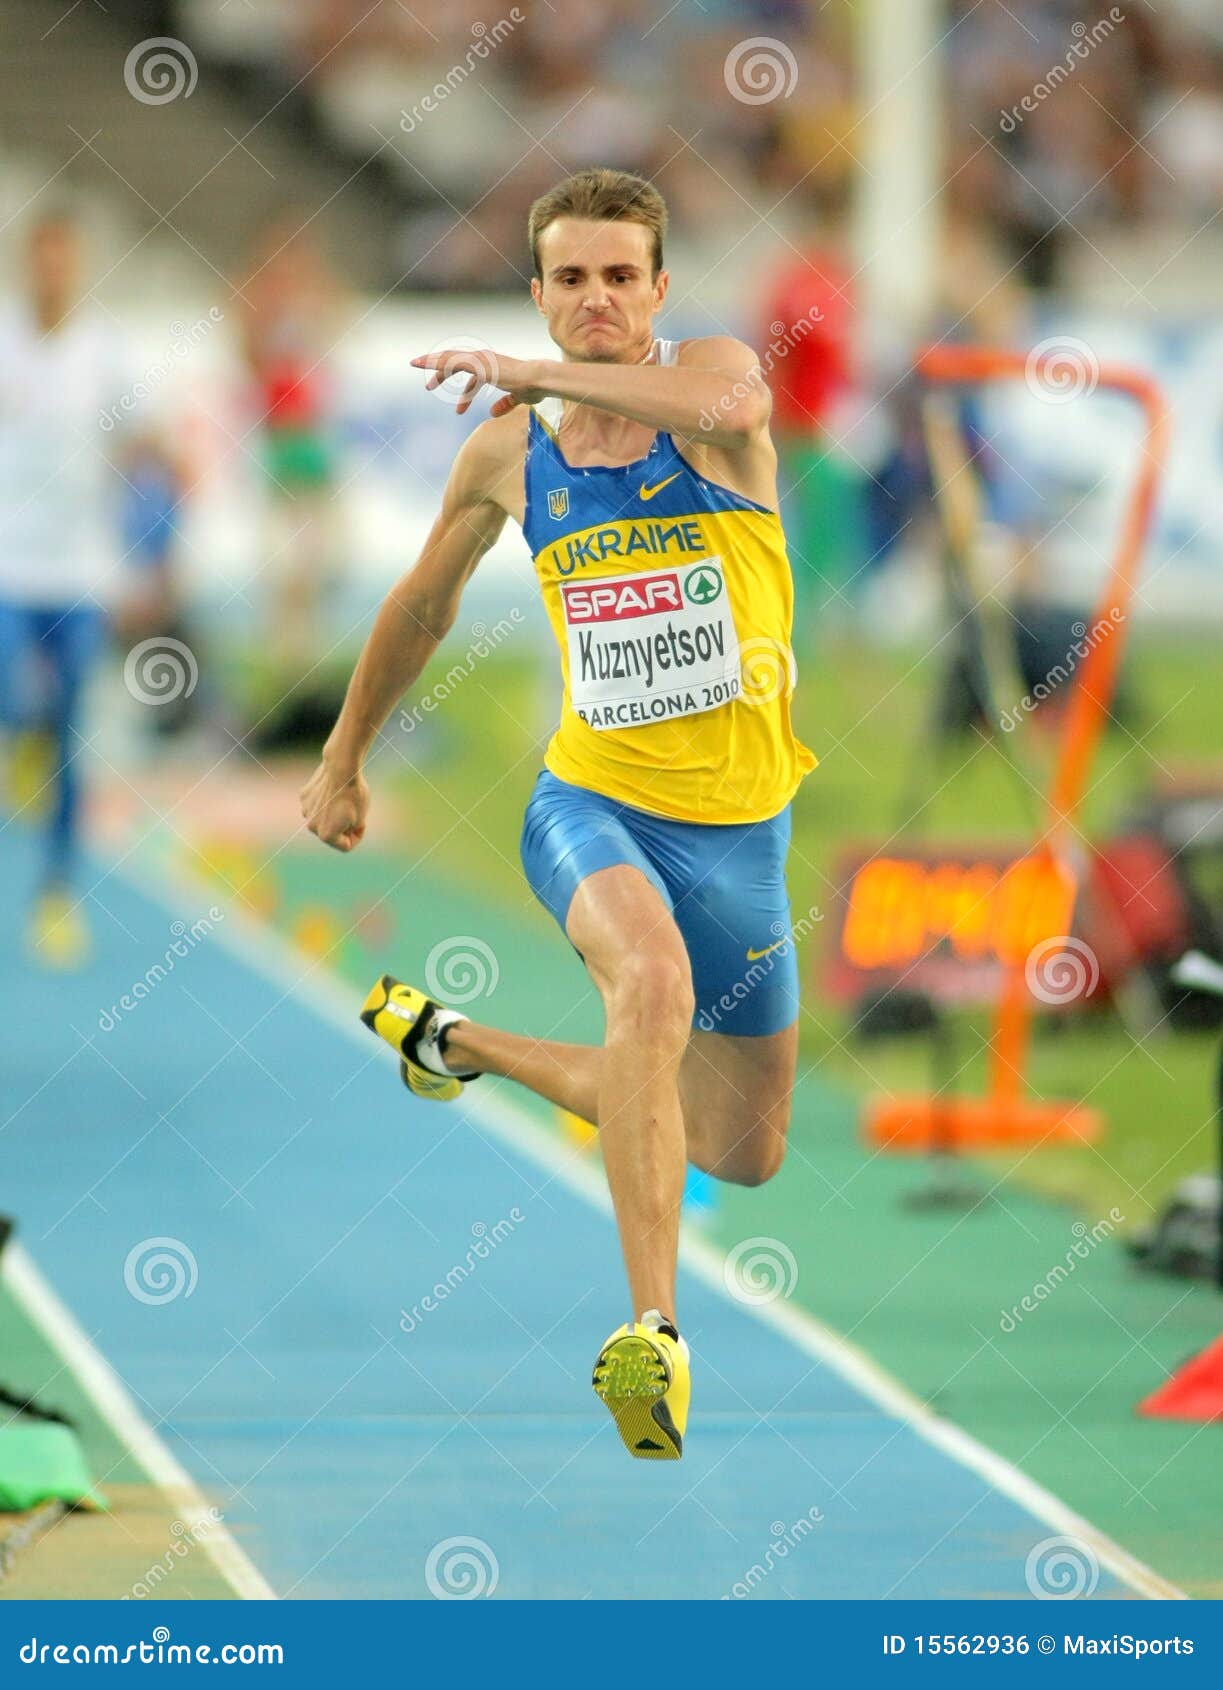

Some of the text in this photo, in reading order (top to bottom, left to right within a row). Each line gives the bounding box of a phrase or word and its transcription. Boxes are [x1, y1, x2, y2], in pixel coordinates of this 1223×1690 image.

[553, 522, 705, 576] UKRAINE
[568, 580, 679, 618] SPAR
[578, 620, 724, 688] Kuznyetsov
[579, 678, 739, 727] BARCELONA 2010
